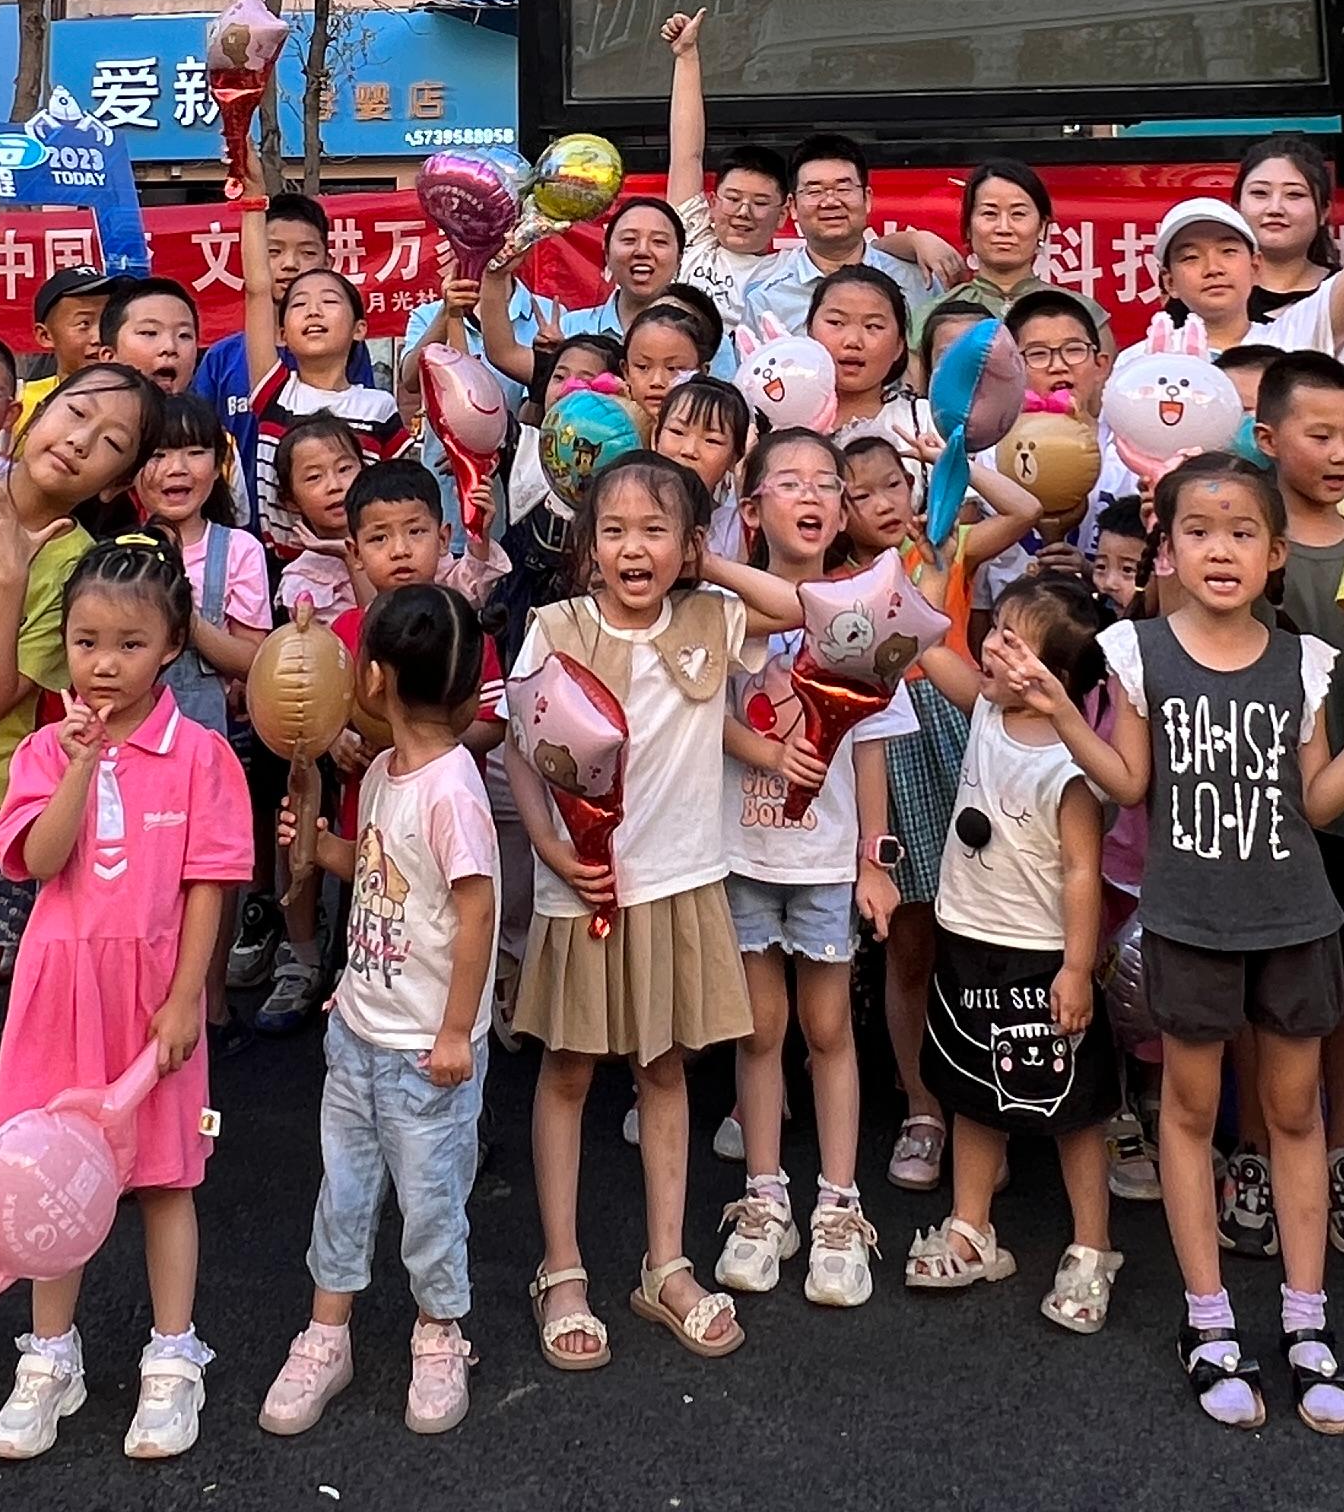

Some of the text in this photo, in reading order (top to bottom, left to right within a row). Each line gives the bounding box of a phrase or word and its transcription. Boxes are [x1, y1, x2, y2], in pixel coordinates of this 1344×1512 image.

[48, 145, 105, 172] 2023
[51, 170, 106, 186] TODAY
[1161, 695, 1290, 781] DAISY
[1172, 782, 1291, 860] LOVE
